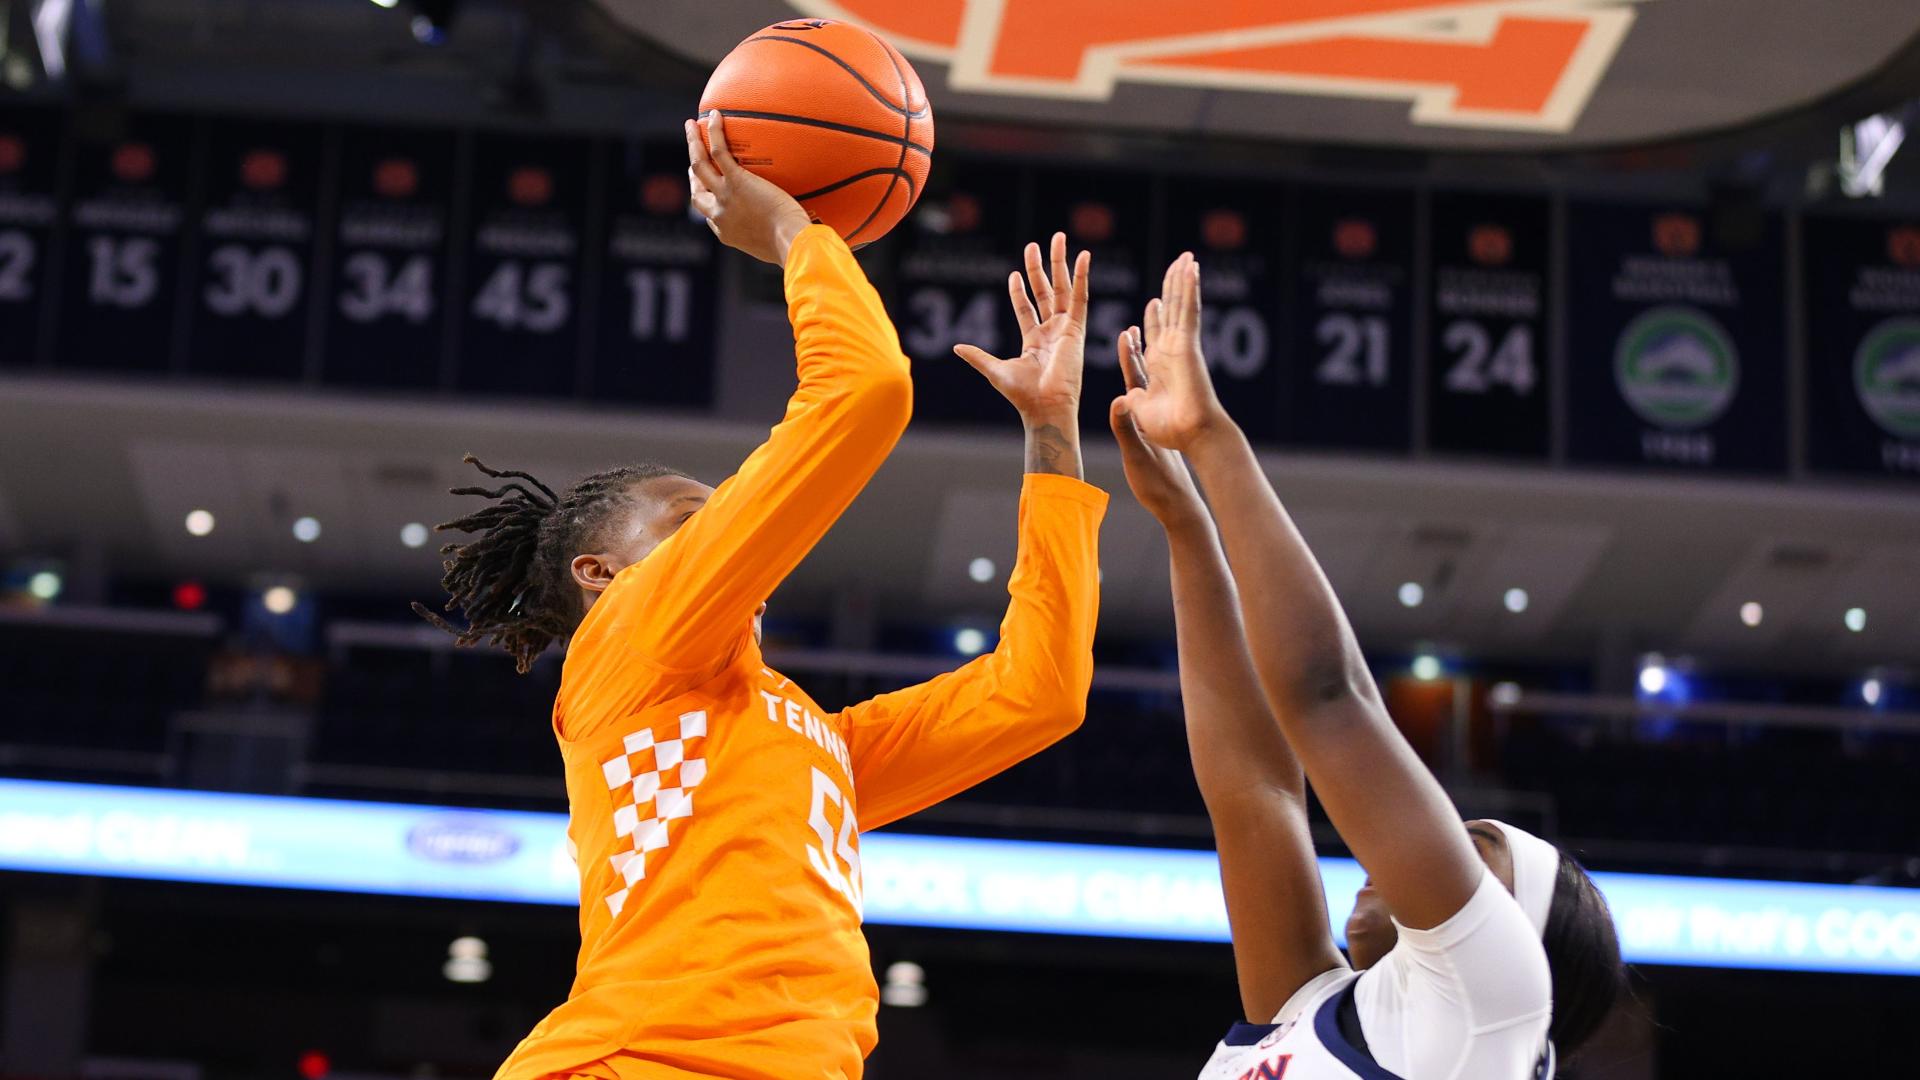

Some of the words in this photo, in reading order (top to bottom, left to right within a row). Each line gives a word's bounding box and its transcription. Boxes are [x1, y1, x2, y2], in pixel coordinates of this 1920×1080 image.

[86, 235, 159, 308] 15
[204, 244, 300, 318] 30
[339, 251, 434, 324] 34
[470, 260, 571, 332] 45
[626, 269, 692, 341] 11
[906, 287, 1001, 360] 34
[1314, 312, 1390, 388] 21
[1441, 320, 1536, 395] 24
[805, 766, 864, 922] 55
